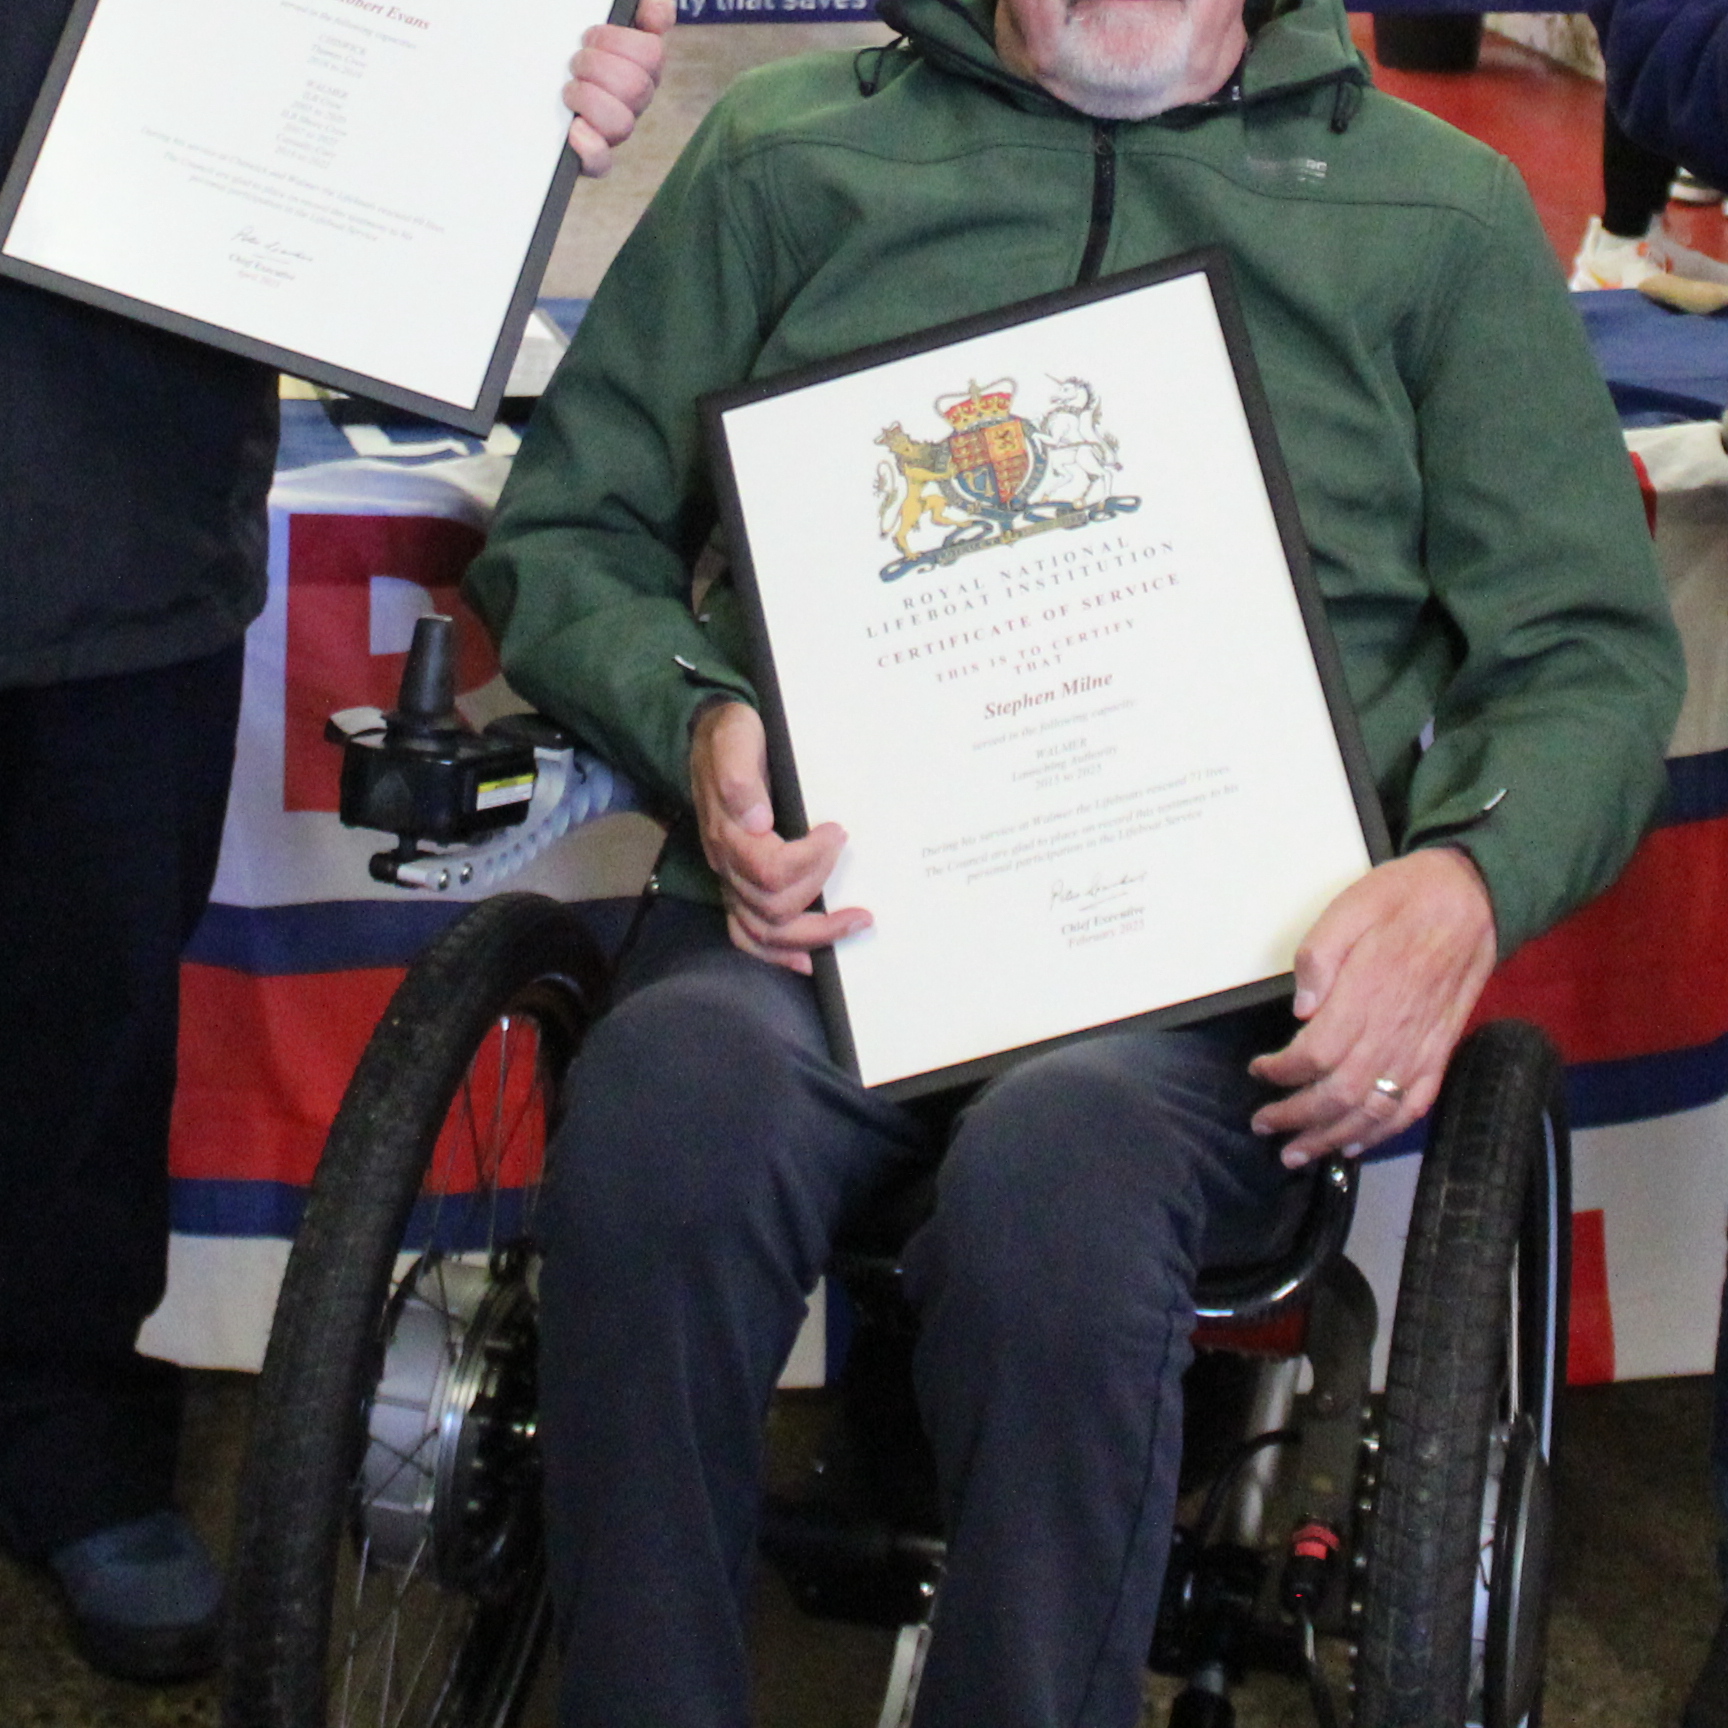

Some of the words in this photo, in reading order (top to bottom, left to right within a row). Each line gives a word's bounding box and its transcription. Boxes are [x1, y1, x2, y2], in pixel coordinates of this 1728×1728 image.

[387, 6, 430, 29] Evans
[865, 594, 990, 638] LIFEBOAT
[1004, 540, 1176, 597] INSTITUTION
[903, 578, 983, 609] ROYAL
[999, 535, 1128, 580] NATIONAL
[877, 616, 1031, 667] CERTIFICATE
[1043, 604, 1070, 621] OF
[1080, 573, 1180, 610] SERVICE
[935, 663, 979, 682] THIS
[988, 654, 1008, 668] IS
[1017, 644, 1041, 660] TO
[1051, 618, 1135, 649] CERTIFY
[982, 687, 1056, 721] Stephen
[1060, 670, 1113, 697] Milne
[1013, 653, 1063, 674] THAT
